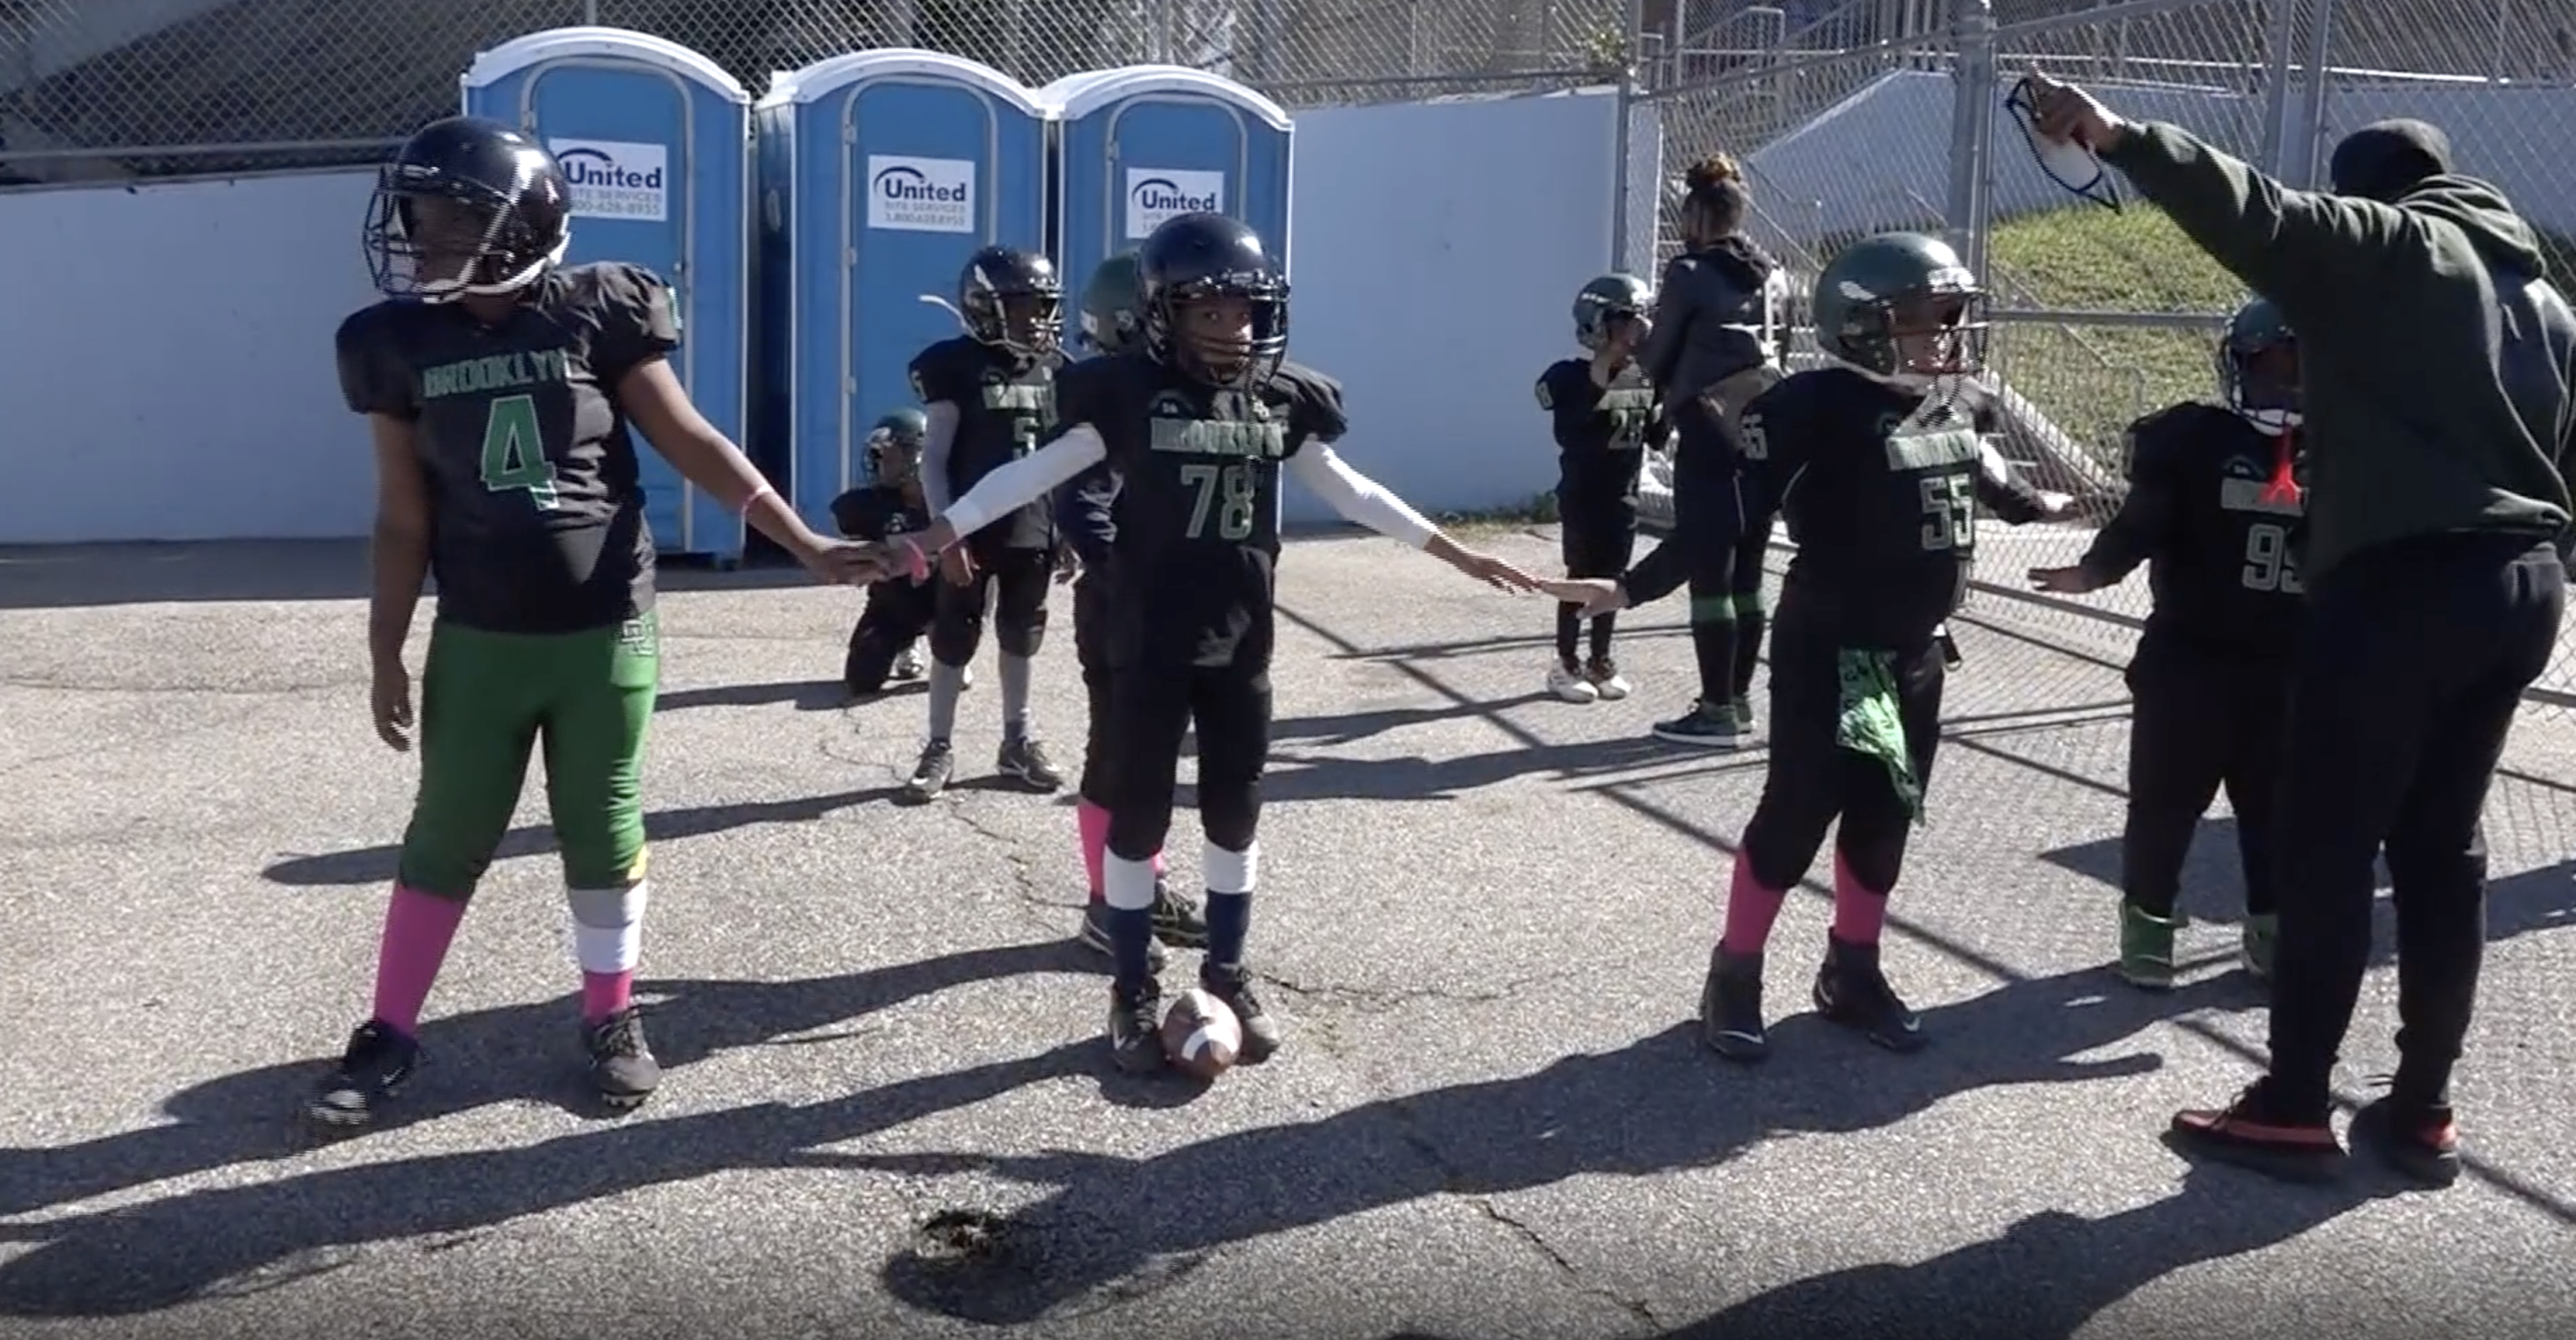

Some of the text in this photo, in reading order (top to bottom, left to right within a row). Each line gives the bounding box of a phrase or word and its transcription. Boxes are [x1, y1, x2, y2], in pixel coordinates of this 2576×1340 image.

[564, 161, 662, 189] United
[885, 179, 966, 202] United
[1142, 190, 1216, 211] United
[480, 394, 560, 511] 4
[1180, 464, 1255, 540] 78
[1919, 472, 1974, 550] 55
